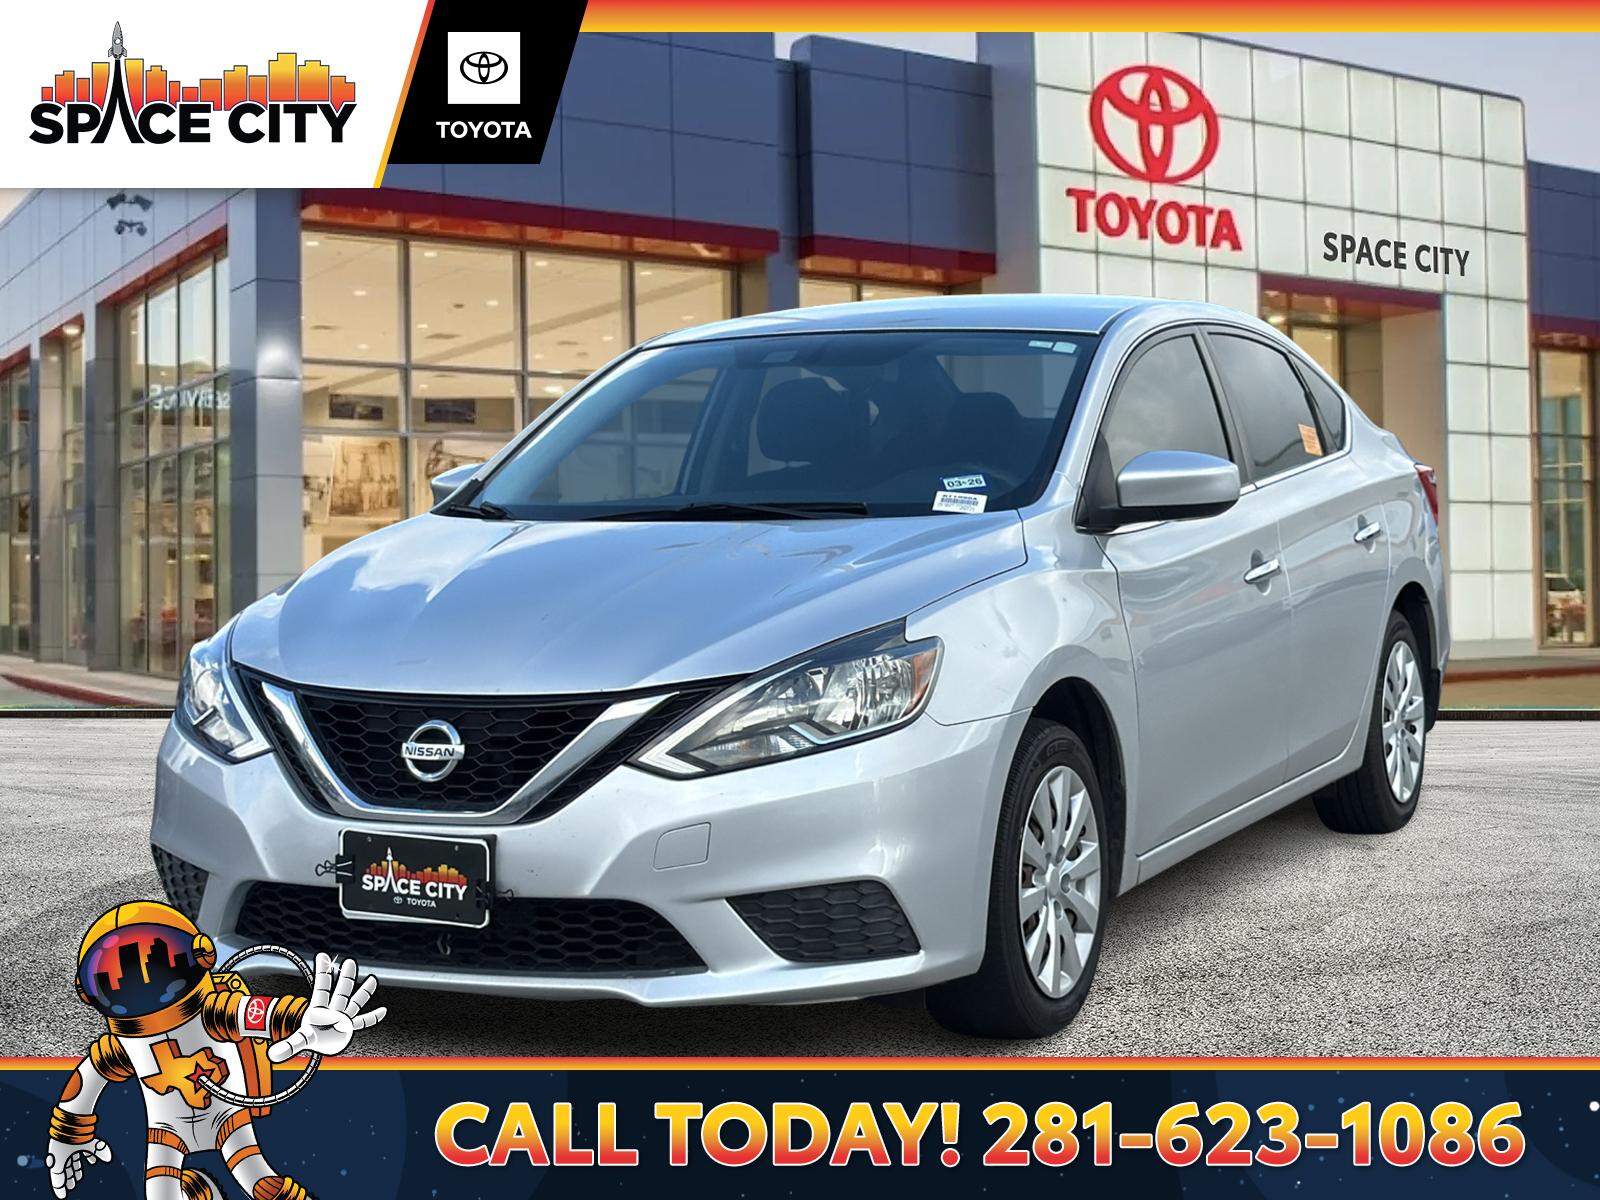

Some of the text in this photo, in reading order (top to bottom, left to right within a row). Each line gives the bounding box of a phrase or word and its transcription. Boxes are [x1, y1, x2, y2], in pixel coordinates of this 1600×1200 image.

[1066, 188, 1242, 251] TOYOTA
[1323, 231, 1470, 276] SPACE CITY
[405, 746, 455, 758] NISSAN
[362, 874, 468, 901] SPACE CITY
[407, 897, 437, 908] TOYOTA
